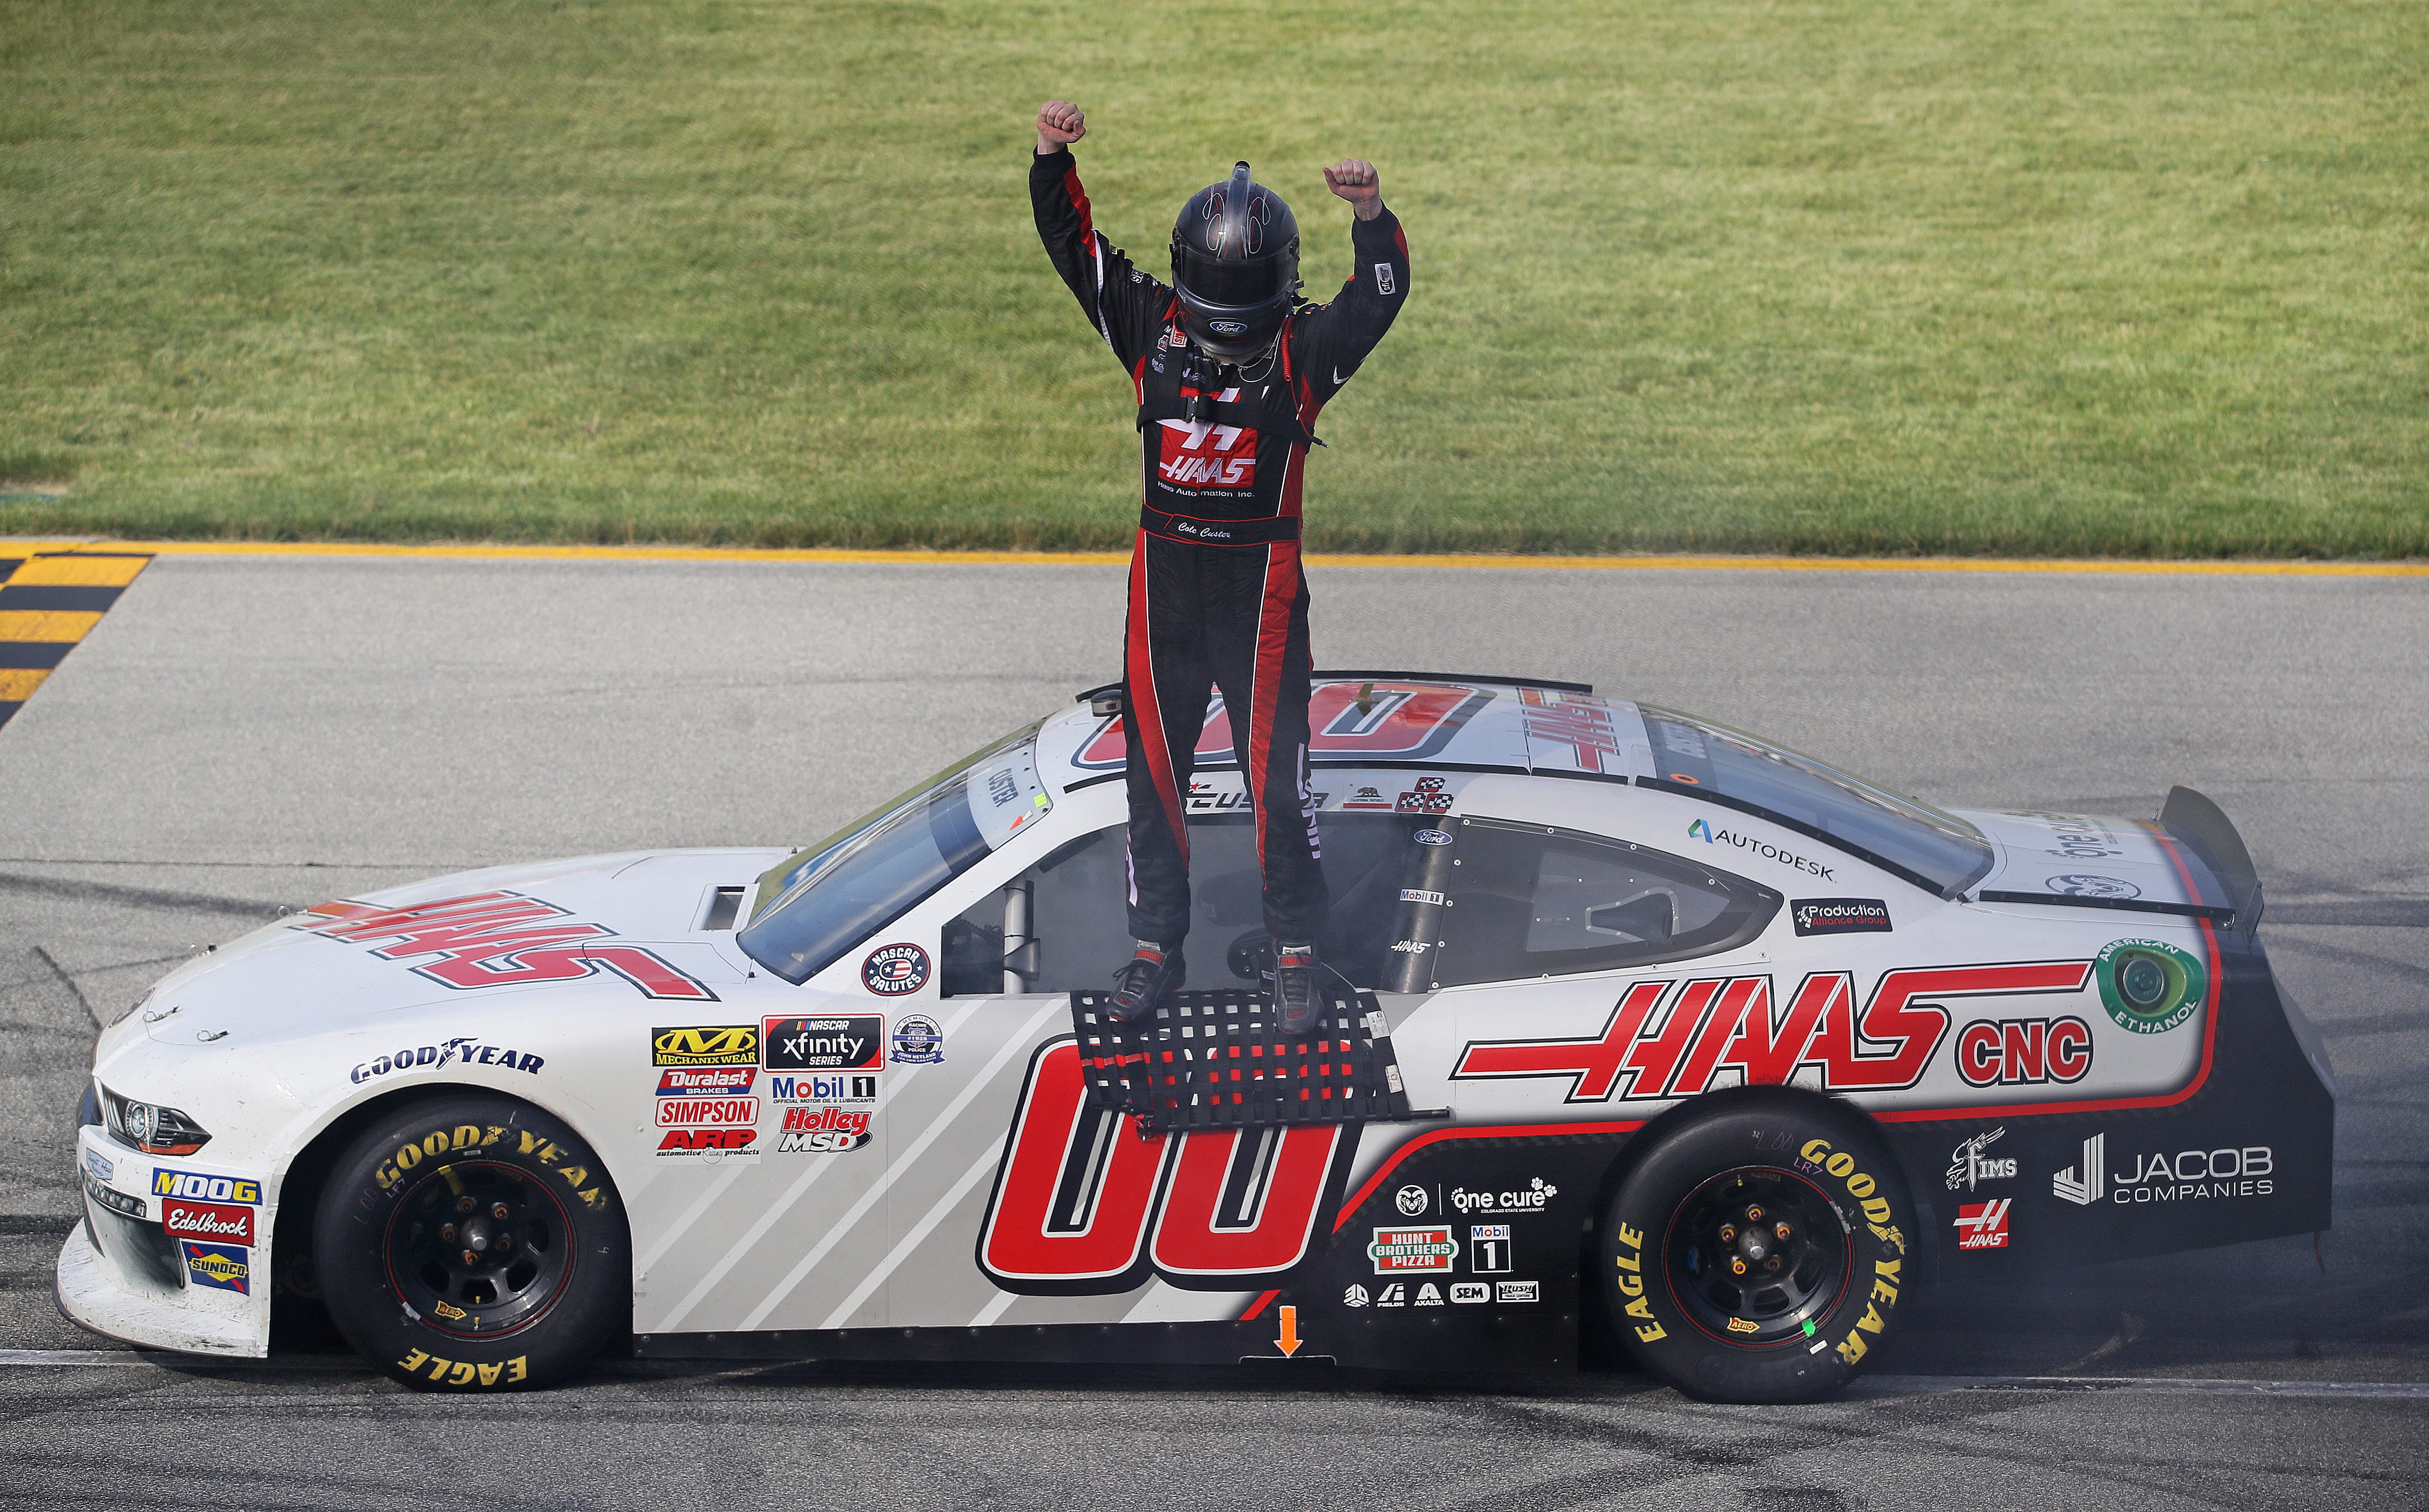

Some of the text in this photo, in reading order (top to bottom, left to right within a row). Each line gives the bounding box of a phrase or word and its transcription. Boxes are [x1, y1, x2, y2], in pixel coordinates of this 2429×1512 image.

[1216, 322, 1239, 333] Ford
[1159, 455, 1256, 484] HAAS
[1158, 480, 1174, 493] Haas
[1178, 522, 1231, 538] Cole Custer
[987, 767, 1020, 808] CUSTER
[1420, 831, 1444, 843] Ford
[1715, 829, 1835, 883] AUTODESK
[1401, 890, 1428, 901] Mobil
[1808, 904, 1885, 918] Production
[1812, 916, 1887, 926] Alliance Group
[1390, 938, 1432, 954] HAAS
[2099, 938, 2179, 963] AMERICAN
[872, 947, 920, 966] NASCAR
[869, 973, 922, 992] SALUTES
[809, 1020, 850, 1031] NASCAR
[902, 1016, 932, 1025] MEMORY
[933, 1025, 940, 1034] OF
[2114, 1000, 2197, 1034] ETHANOL
[1450, 960, 2097, 1103] HAAS
[782, 1032, 865, 1060] xfinity
[1956, 1015, 2093, 1088] CNC
[655, 1051, 756, 1065] MECHANIX WEAR
[809, 1056, 843, 1066] SERIES
[667, 1069, 748, 1086] Duralast
[772, 1076, 844, 1098] Mobil
[662, 1101, 753, 1123] SIMPSON
[782, 1107, 871, 1136] Holley
[657, 1130, 758, 1150] ARP
[778, 1132, 858, 1152] MSD
[725, 1148, 760, 1156] products
[2114, 1146, 2273, 1184] JACOB
[154, 1171, 257, 1202] MOOG
[2114, 1180, 2273, 1204] COMPANIES
[1453, 1190, 1546, 1209] one cure
[168, 1208, 248, 1237] Edelbrock
[1391, 1232, 1434, 1244] HUNT
[1472, 1226, 1509, 1238] Mobil
[1959, 1232, 2009, 1248] HAAS
[1375, 1243, 1450, 1256] BROTHERS
[1482, 1241, 1496, 1270] 1
[192, 1259, 245, 1277] SUNOCO
[1391, 1255, 1435, 1267] PIZZA
[1502, 1285, 1533, 1294] RUSH
[1616, 1221, 1668, 1343] EAGLE
[1456, 1286, 1484, 1299] SEM
[439, 1306, 461, 1316] AERO
[1731, 1321, 1753, 1330] AERO
[397, 1347, 527, 1386] EAGLE
